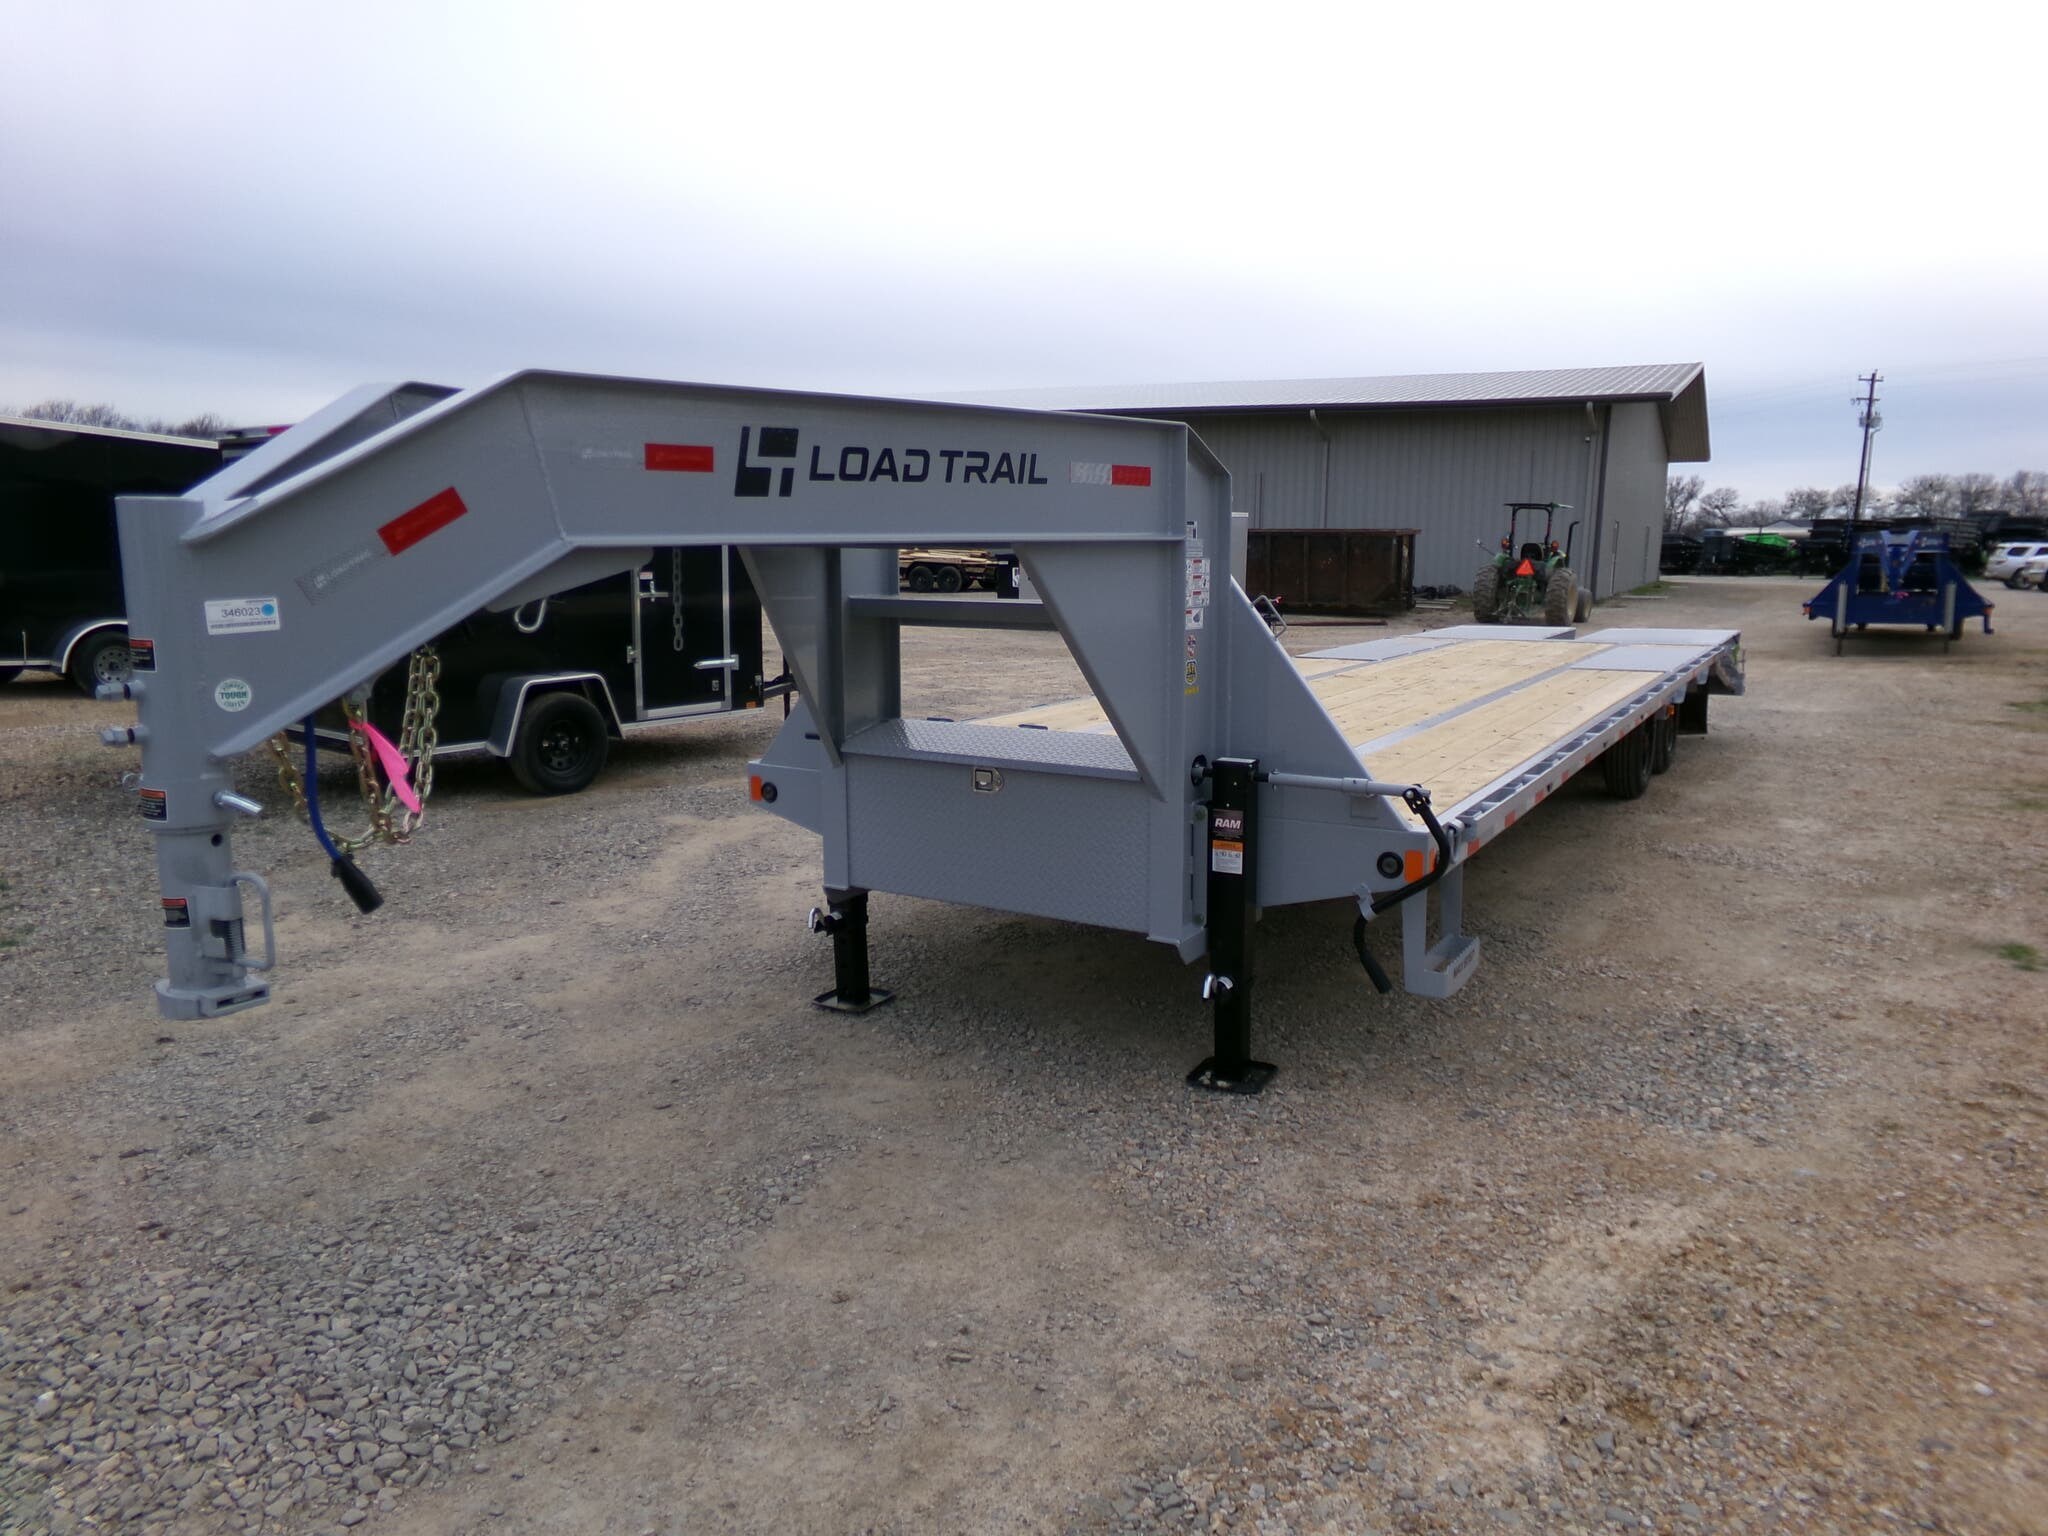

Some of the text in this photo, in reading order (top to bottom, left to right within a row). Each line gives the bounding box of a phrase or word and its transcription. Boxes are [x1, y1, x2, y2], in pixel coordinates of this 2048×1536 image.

[809, 445, 1048, 485] LOAD TRAIL
[221, 606, 260, 618] 346023
[1214, 818, 1241, 829] RAM
